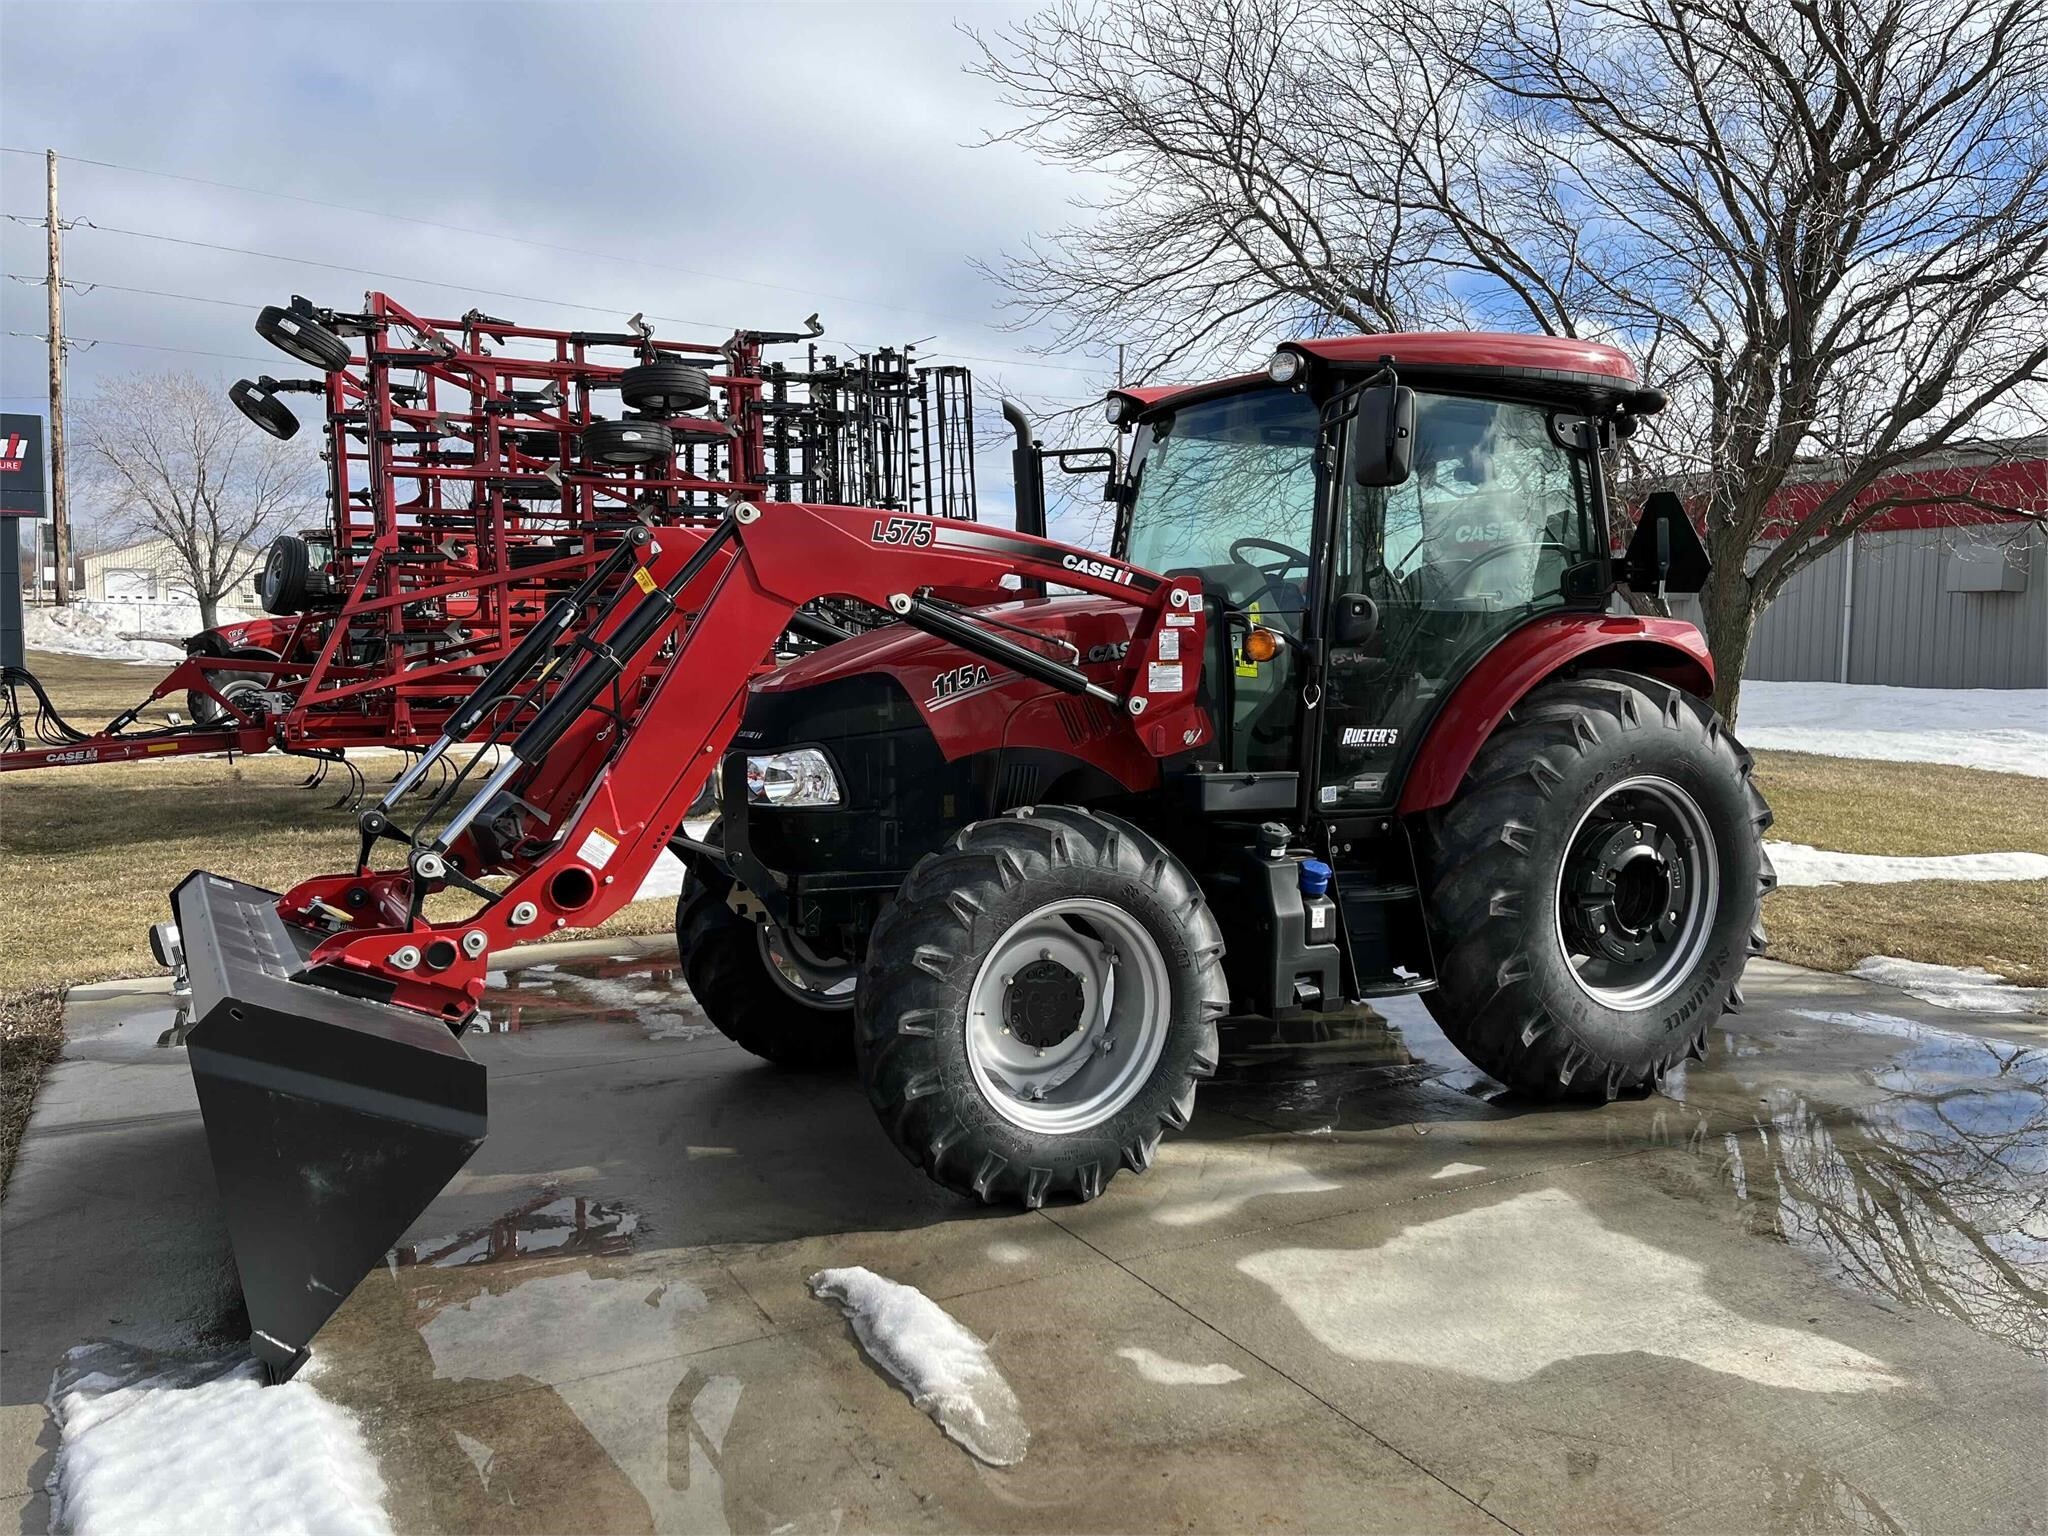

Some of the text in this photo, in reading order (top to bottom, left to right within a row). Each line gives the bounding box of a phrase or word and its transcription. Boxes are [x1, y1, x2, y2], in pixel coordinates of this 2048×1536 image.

[871, 517, 933, 548] L575
[1062, 554, 1115, 581] CASE
[1088, 641, 1130, 662] CAS
[932, 664, 992, 699] 115A
[1342, 727, 1399, 745] RUETER'S
[46, 751, 85, 762] CASE
